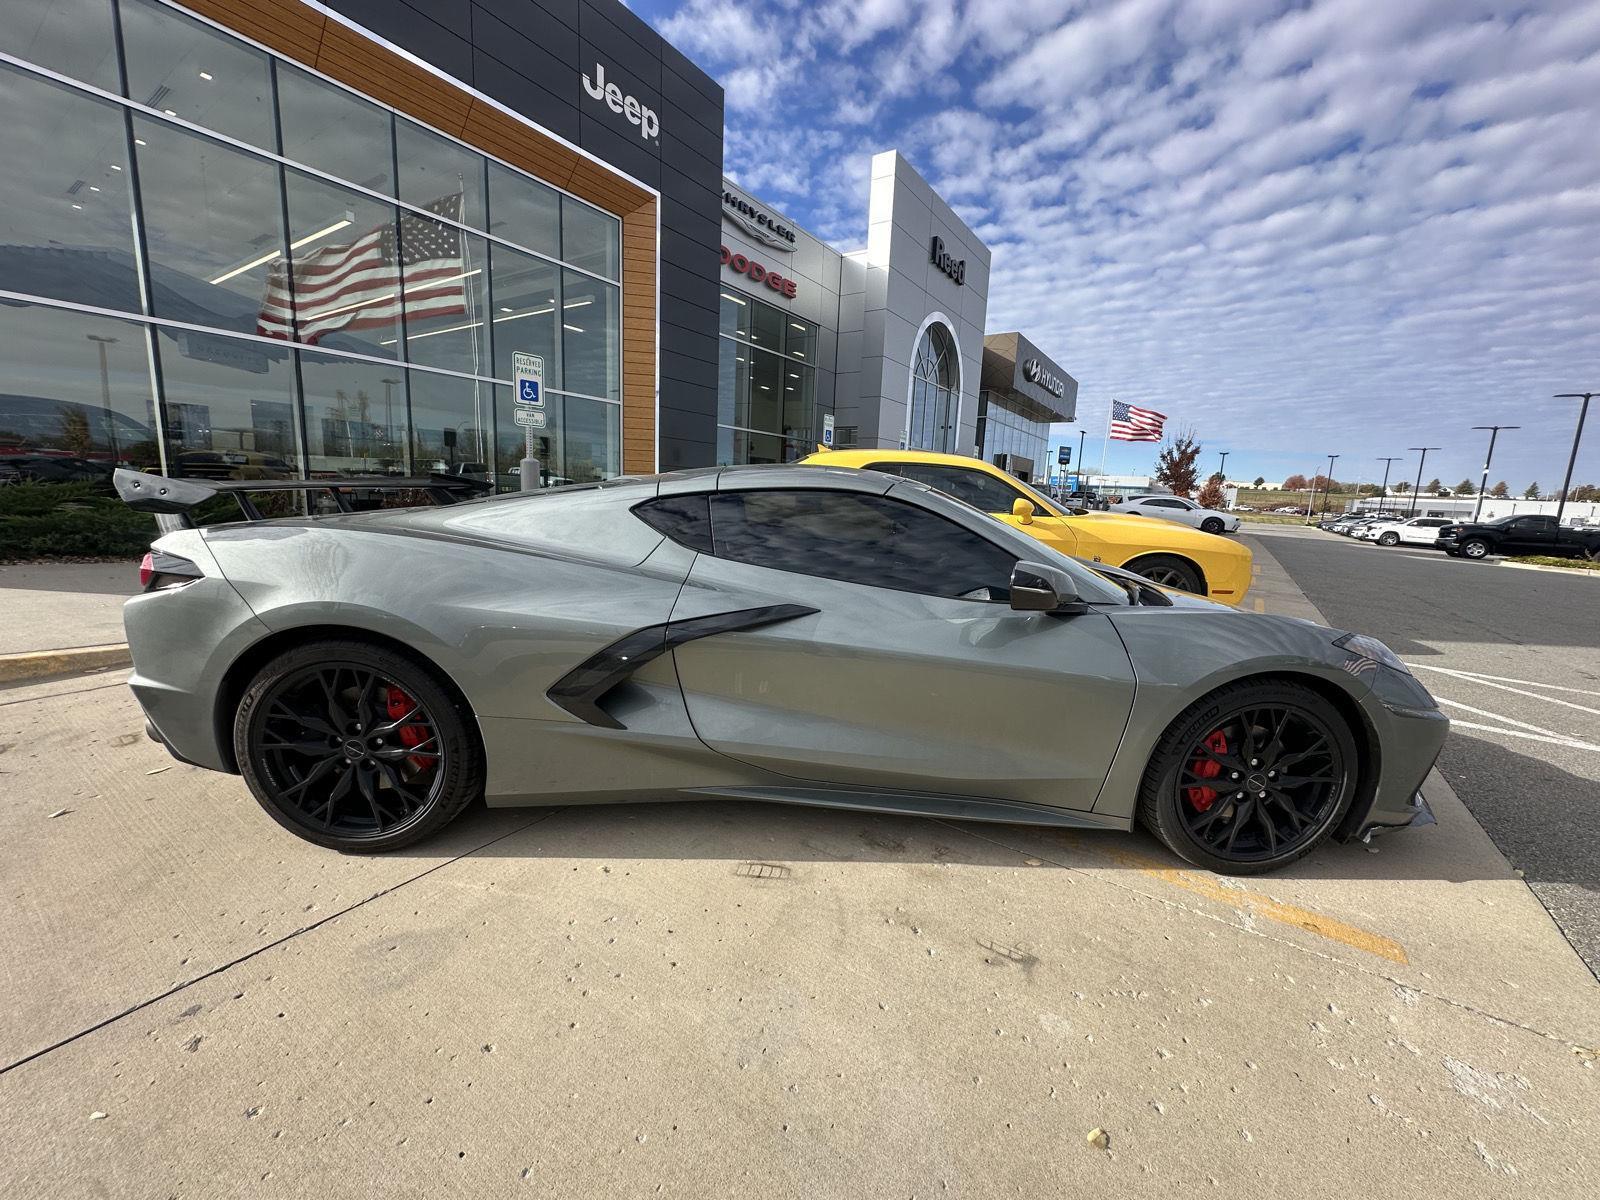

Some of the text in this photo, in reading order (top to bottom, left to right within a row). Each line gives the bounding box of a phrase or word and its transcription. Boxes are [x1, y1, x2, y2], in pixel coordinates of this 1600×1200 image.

[582, 63, 660, 140] Jeep
[721, 189, 796, 243] HRYSLER
[720, 244, 797, 299] DODGE
[930, 235, 966, 286] Reed
[516, 357, 541, 368] RESERVED
[516, 366, 541, 377] PARKING
